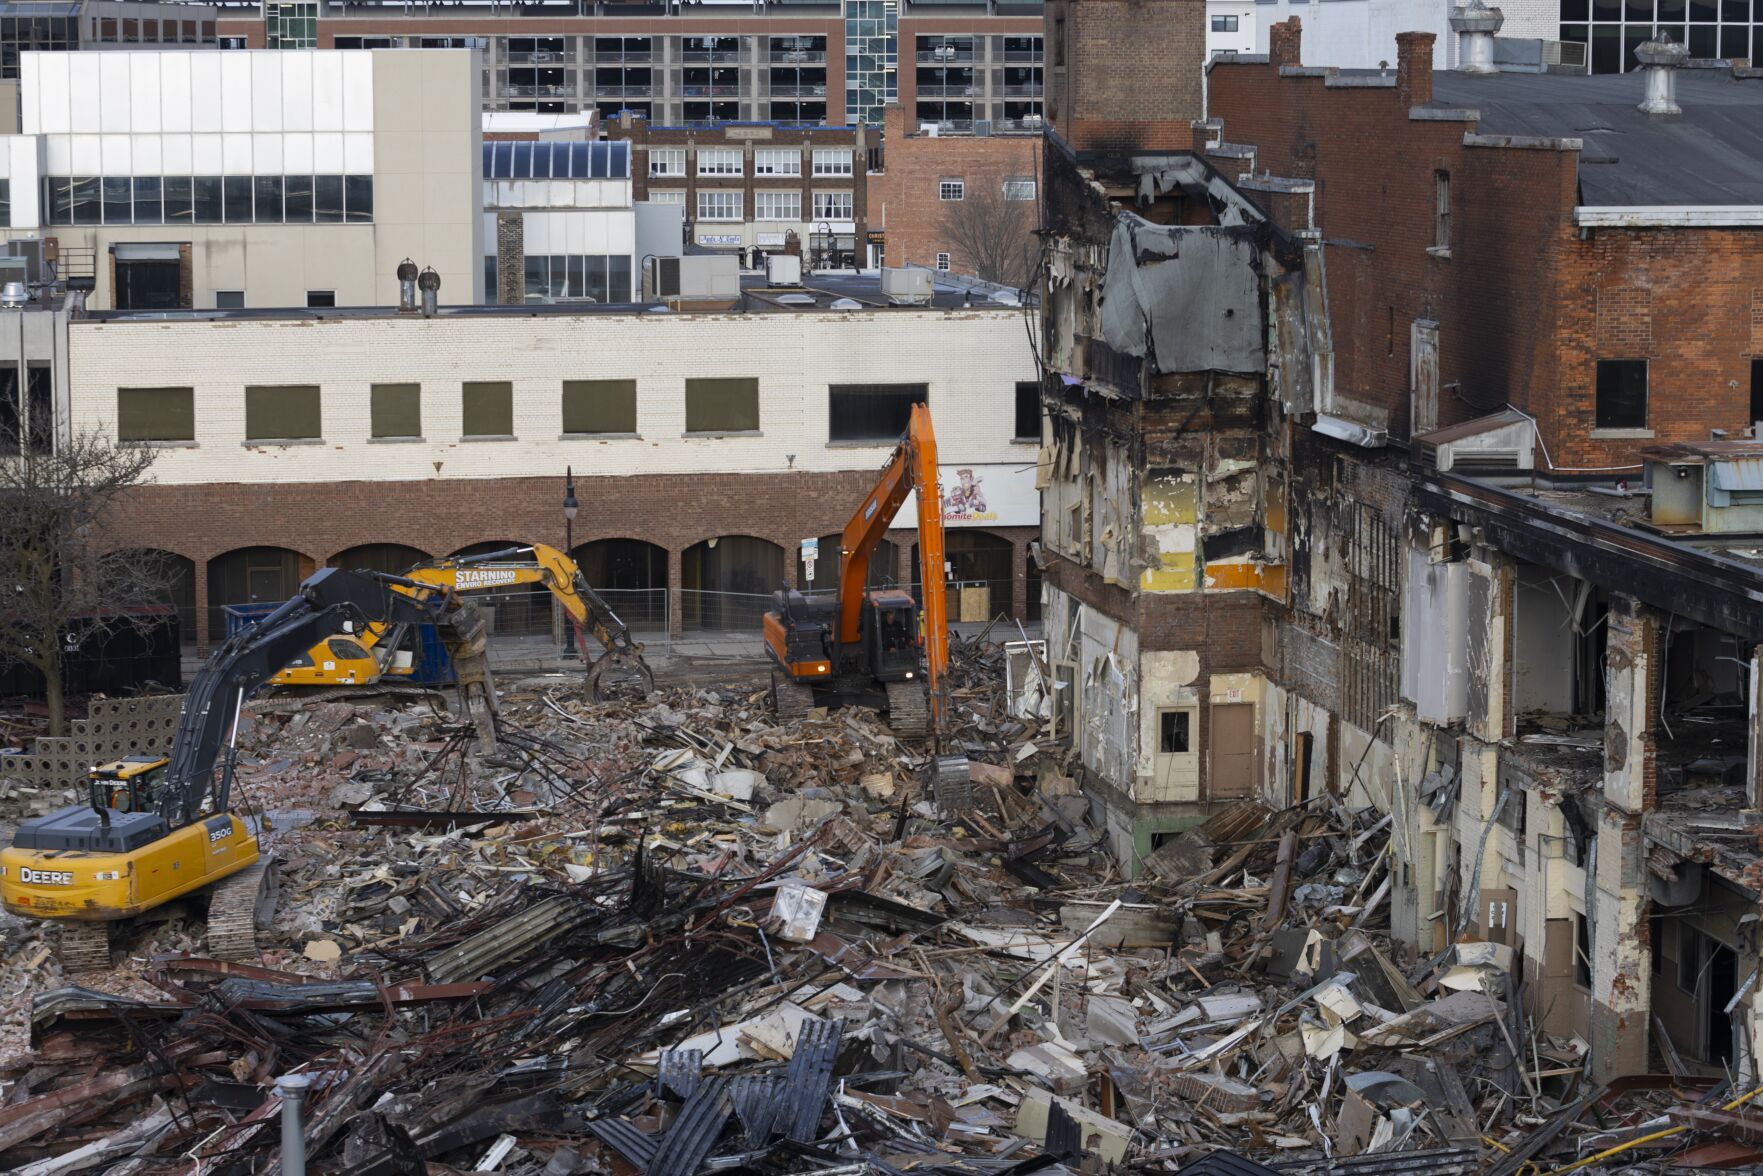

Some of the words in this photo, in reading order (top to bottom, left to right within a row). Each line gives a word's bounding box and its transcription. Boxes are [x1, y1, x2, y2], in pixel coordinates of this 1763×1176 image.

[456, 571, 515, 582] STARNINO
[210, 827, 232, 842] 350G
[20, 866, 74, 885] DEERE
